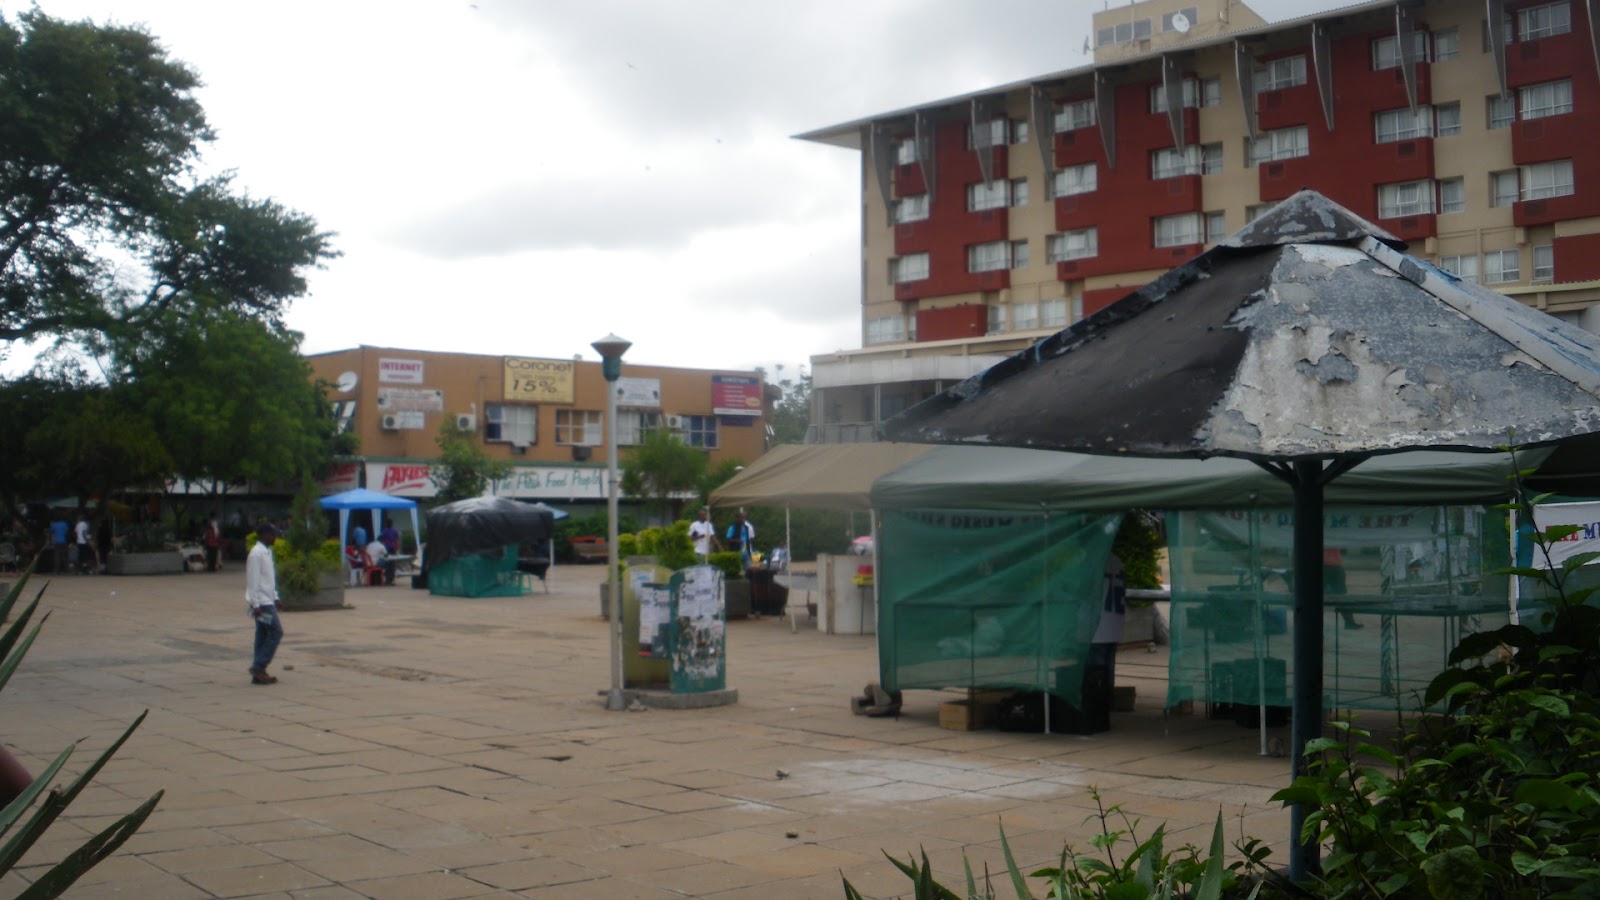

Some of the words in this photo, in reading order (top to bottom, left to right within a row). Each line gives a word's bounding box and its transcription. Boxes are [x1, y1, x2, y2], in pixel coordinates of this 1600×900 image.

[380, 361, 421, 372] INTERNET
[506, 358, 572, 372] Coronet
[512, 379, 557, 393] 15%
[544, 470, 568, 488] Food
